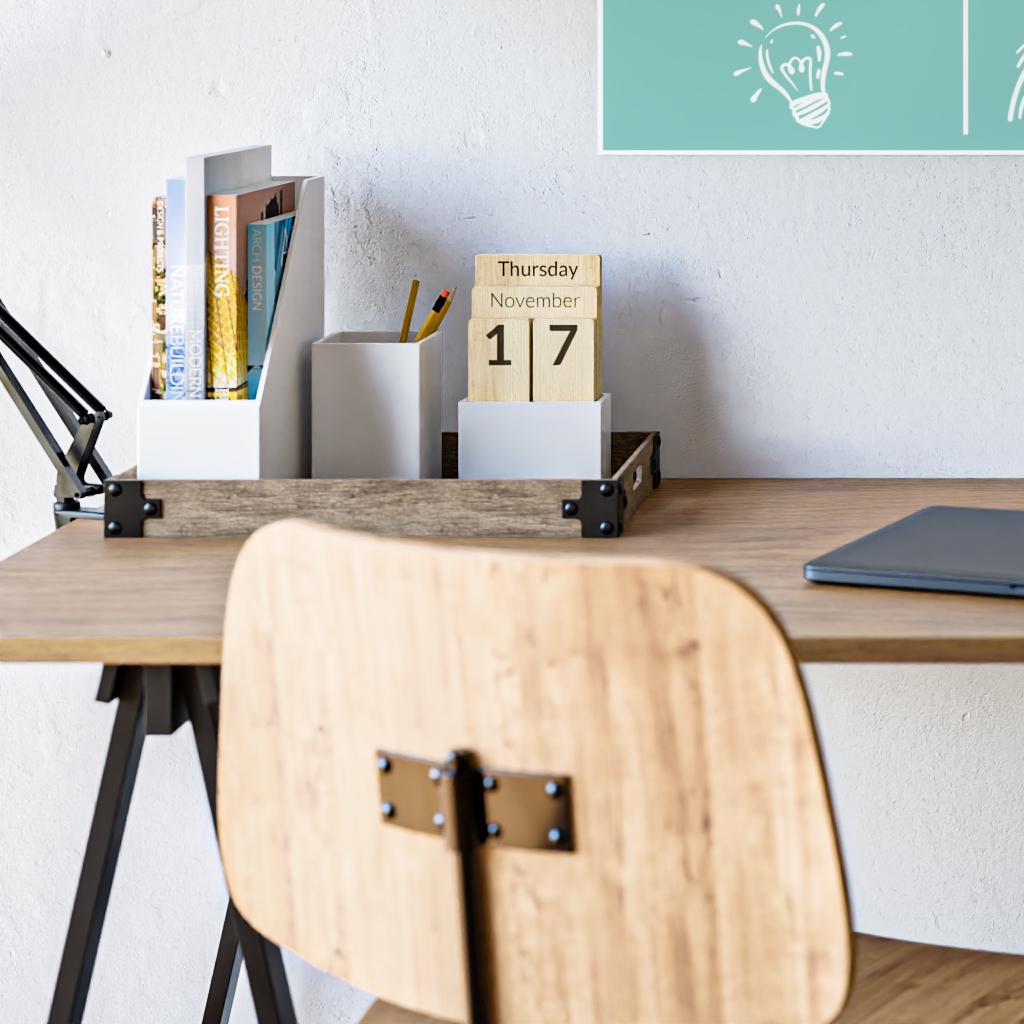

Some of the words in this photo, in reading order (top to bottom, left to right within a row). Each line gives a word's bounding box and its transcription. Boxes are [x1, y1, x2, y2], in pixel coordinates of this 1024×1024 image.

[214, 206, 230, 298] LIGHTING
[252, 229, 262, 261] ARCH
[498, 261, 578, 280] Thursday
[252, 265, 262, 311] DESIGN
[490, 293, 580, 309] November
